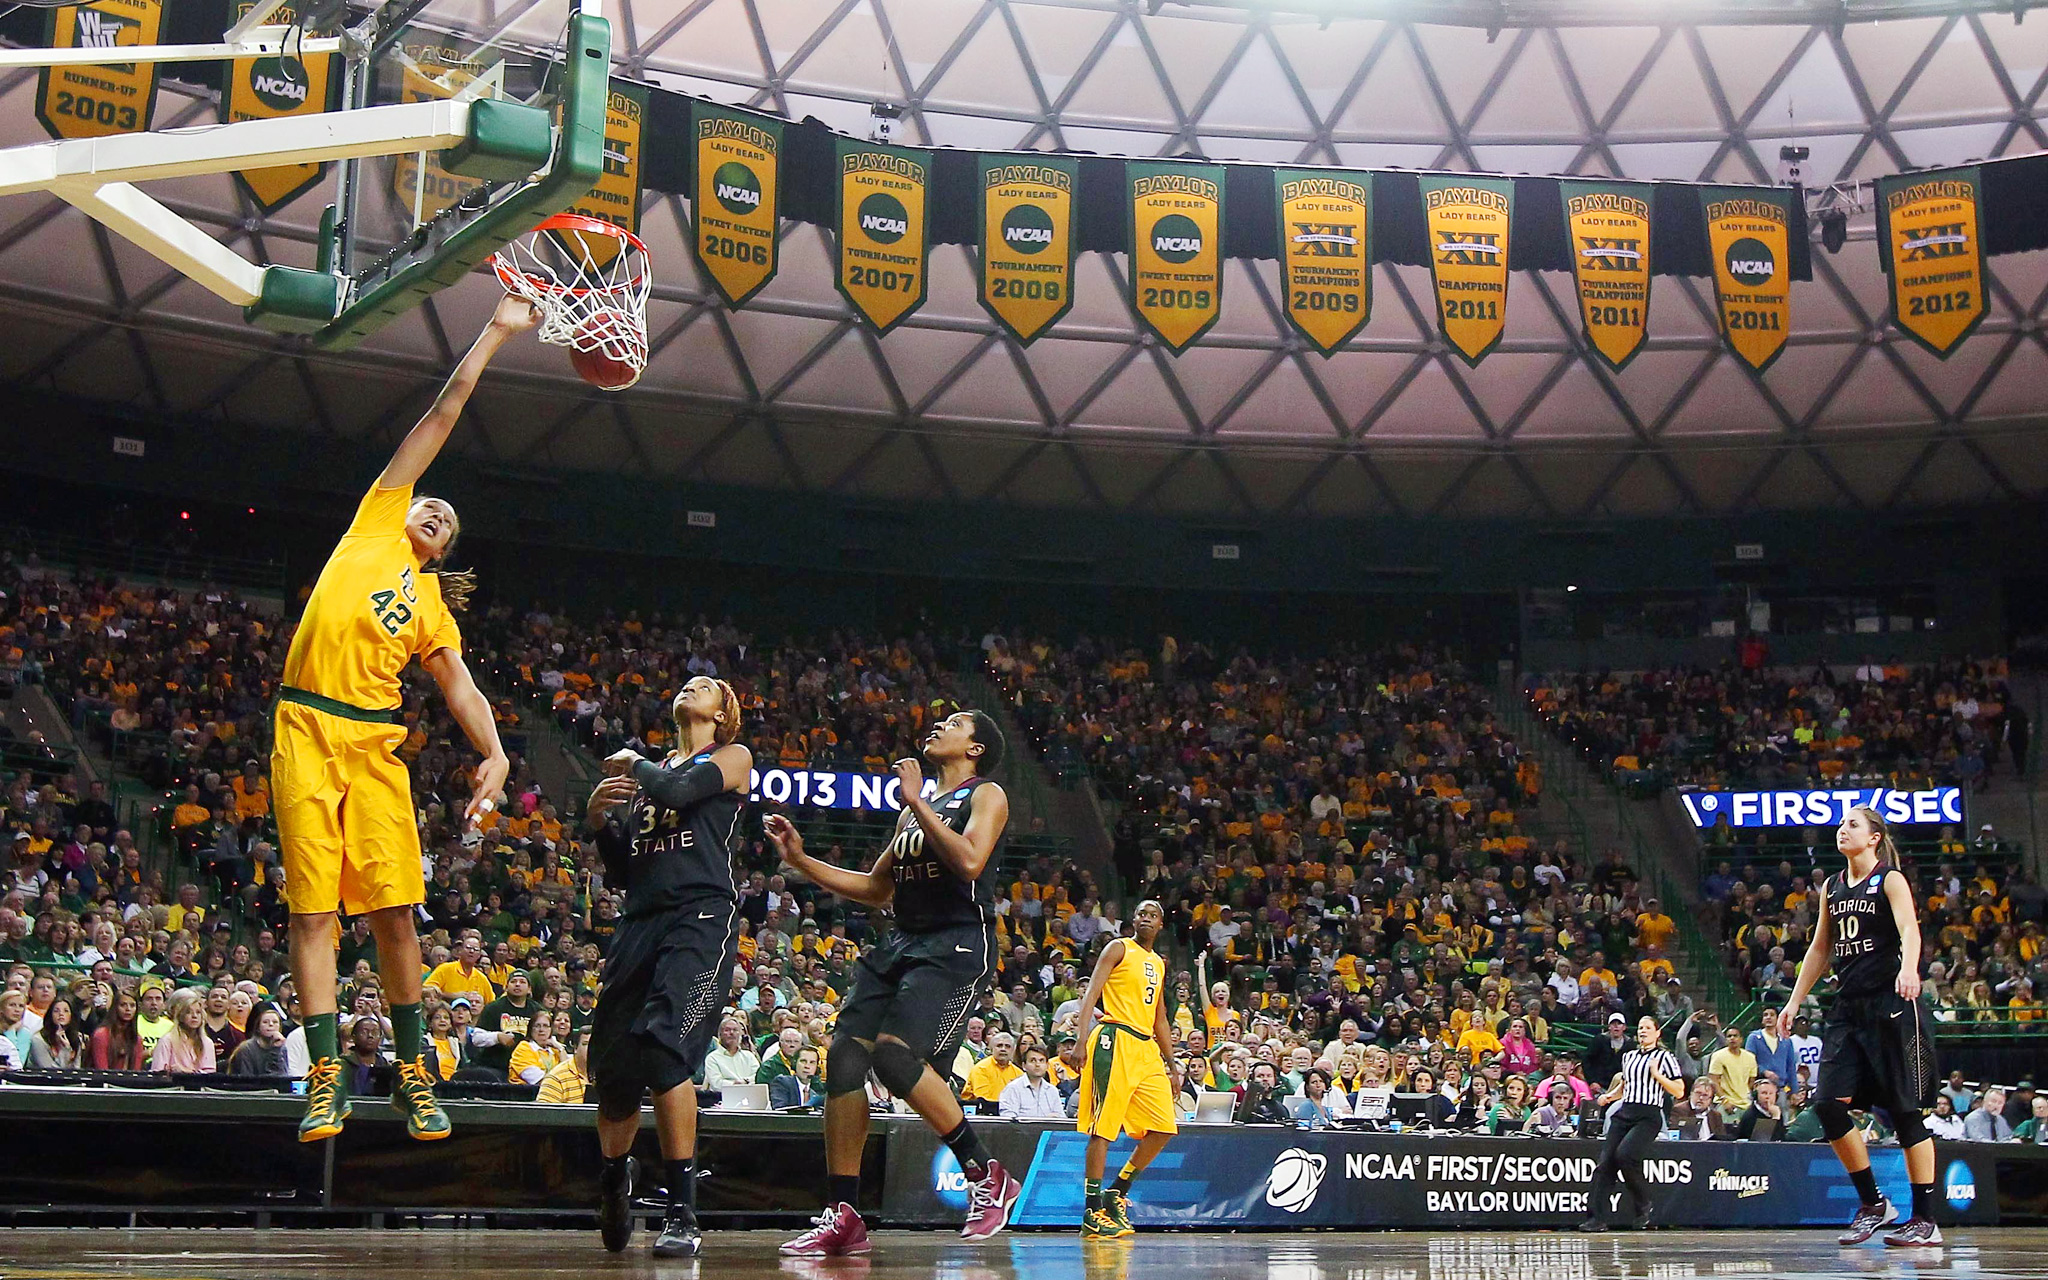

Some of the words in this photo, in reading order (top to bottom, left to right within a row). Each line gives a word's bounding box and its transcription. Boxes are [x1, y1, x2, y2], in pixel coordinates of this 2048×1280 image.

[255, 75, 306, 101] NCAA
[56, 91, 138, 129] 2003
[606, 116, 629, 129] EARS
[699, 118, 777, 155] BAYLOR
[710, 141, 734, 155] LADY
[735, 148, 765, 161] BEARS
[843, 153, 925, 186] BAYLOR
[985, 165, 1071, 193] BAYLOR
[855, 175, 880, 187] LADY
[882, 180, 913, 191] BEARS
[1134, 175, 1218, 201] BAYLOR
[1283, 178, 1366, 206] BAYLOR
[717, 183, 760, 206] NCAA
[998, 189, 1024, 198] LADY
[1026, 190, 1058, 199] BEARS
[1147, 199, 1172, 207] LADY
[1174, 200, 1206, 209] BEARS
[1427, 187, 1509, 216] BAYLOR
[1888, 181, 1975, 212] BAYLOR
[1296, 203, 1320, 211] LADY
[1322, 205, 1354, 213] BEARS
[1440, 212, 1465, 221] LADY
[1467, 213, 1496, 221] BEARS
[1569, 193, 1650, 220] BAYLOR
[1707, 200, 1786, 226] BAYLOR
[1902, 207, 1928, 219] LADY
[1930, 203, 1962, 214] BEARS
[862, 214, 907, 235] NCAA
[1581, 218, 1606, 226] LADY
[1608, 219, 1638, 228] BEARS
[1720, 223, 1744, 232] LADY
[1746, 224, 1777, 233] BEARS
[1005, 227, 1052, 244] NCAA
[1155, 236, 1201, 253] NCAA
[1292, 222, 1358, 258] XII
[1899, 222, 1969, 263] XII
[705, 234, 767, 265] 2006
[847, 247, 918, 266] TOURNAMENT
[1436, 230, 1502, 267] XII
[1580, 236, 1643, 273] XII
[990, 260, 1064, 274] TOURNAMENT
[1293, 266, 1360, 276] TOURNAMENT
[1731, 260, 1774, 275] NCAA
[849, 265, 915, 293] 2007
[992, 278, 1060, 301] 2008
[1293, 276, 1360, 287] CHAMPIONS
[1439, 280, 1503, 292] CHAMPIONS
[1903, 270, 1973, 288] CHAMPIONS
[1144, 288, 1211, 309] 2009
[1294, 292, 1359, 313] 2009
[1909, 290, 1972, 317] 2012
[1446, 299, 1498, 321] 2011
[1590, 306, 1641, 327] 2011
[1729, 310, 1780, 331] 2011
[371, 590, 411, 635] 42
[750, 769, 836, 807] 2013
[631, 830, 694, 857] STATE
[894, 828, 925, 860] 00
[1838, 915, 1859, 940] 10
[1835, 938, 1874, 957] STATE
[1145, 987, 1155, 1005] 3
[1800, 1047, 1820, 1064] 22
[1427, 1154, 1597, 1185] FIRST/SECOND
[1709, 1175, 1769, 1190] PINNACLE
[1945, 1184, 1976, 1199] NCAA
[1427, 1191, 1508, 1212] BAYLOR
[1512, 1192, 1622, 1213] UNIVERSY
